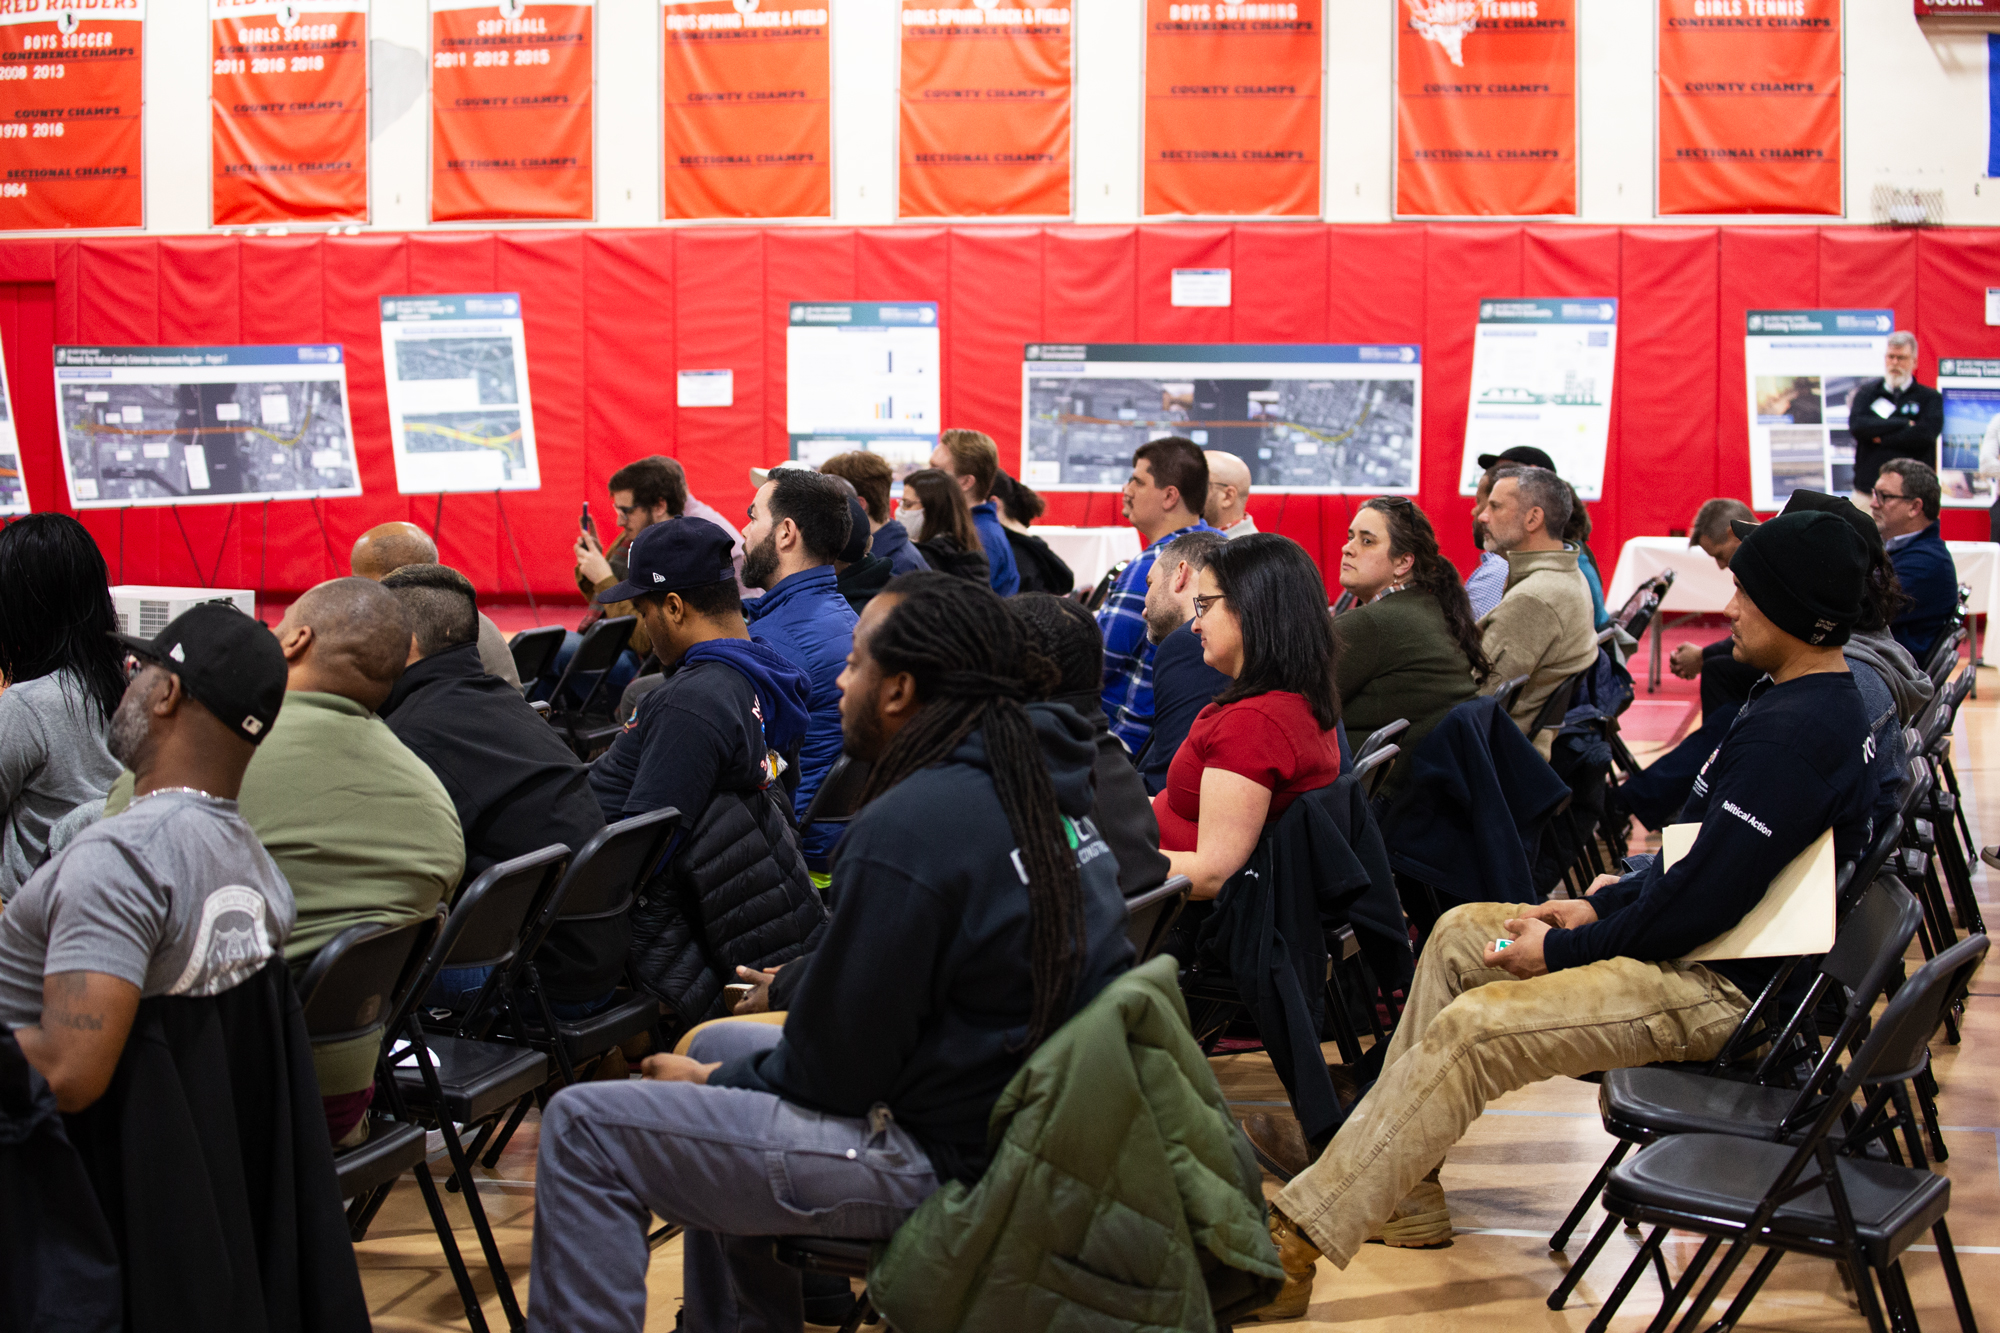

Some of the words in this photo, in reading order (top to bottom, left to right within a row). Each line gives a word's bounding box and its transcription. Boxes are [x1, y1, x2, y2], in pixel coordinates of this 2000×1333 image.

[0, 0, 39, 14] RED
[1169, 4, 1211, 21] BOYS
[1215, 3, 1298, 20] SWIMMING
[1481, 1, 1538, 18] TENNIS
[1694, 0, 1742, 16] GIRLS
[1748, 0, 1805, 16] TENNIS
[477, 17, 547, 36] SOFTBALL
[1504, 20, 1566, 28] CHAMPS
[1768, 18, 1831, 27] CHAMPS
[238, 27, 280, 44] GIRLS
[284, 24, 337, 42] SOCCER
[24, 34, 57, 50] BOYS
[61, 32, 113, 49] SOCCER
[2, 50, 79, 60] CONFERENCE
[81, 47, 134, 57] CHAMPS
[434, 52, 466, 68] 2011
[473, 50, 509, 67] 2012
[33, 64, 65, 79] 2013
[214, 58, 245, 74] 2011
[251, 57, 286, 73] 2016
[1234, 85, 1295, 93] CHAMPS
[1424, 84, 1482, 93] COUNTY
[1488, 83, 1549, 92] CHAMPS
[1685, 82, 1745, 92] COUNTY
[1751, 82, 1814, 92] CHAMPS
[15, 109, 64, 118] COUNTY
[67, 107, 120, 116] CHAMPS
[233, 103, 284, 112] COUNTY
[290, 101, 343, 110] CHAMPS
[33, 122, 64, 138] 2016
[1243, 150, 1303, 159] CHAMPS
[1498, 150, 1558, 158] CHAMPS
[1676, 148, 1754, 157] SECTIONAL
[1760, 148, 1824, 157] CHAMPS
[7, 168, 71, 178] SECTIONAL
[75, 166, 127, 176] CHAMPS
[298, 161, 351, 171] CHAMPS
[1747, 816, 1772, 837] Action
